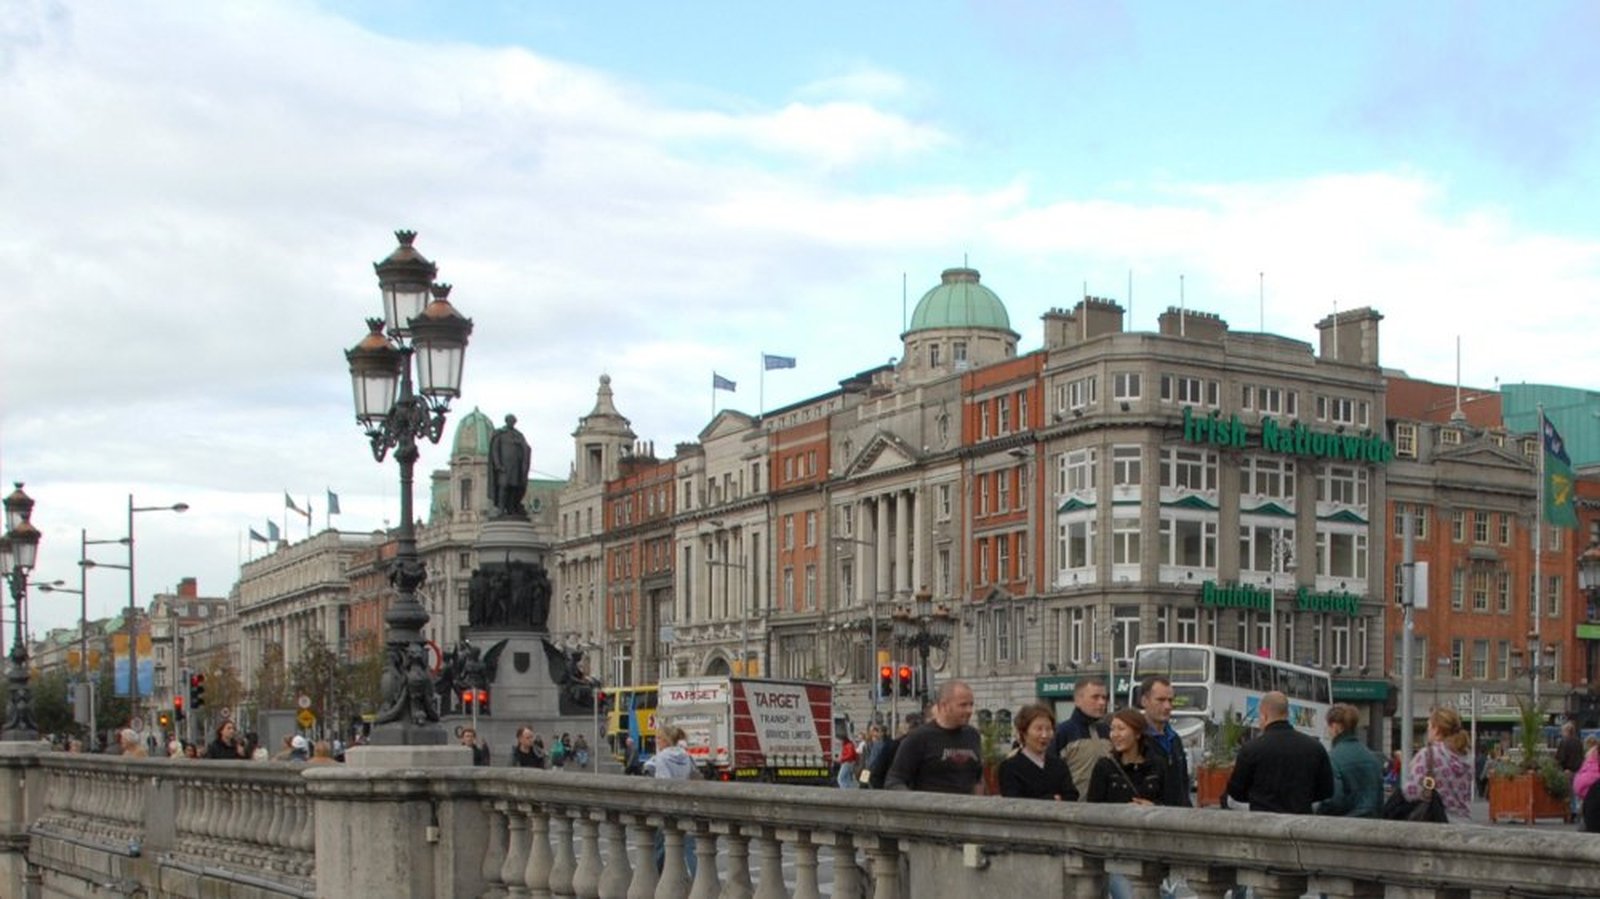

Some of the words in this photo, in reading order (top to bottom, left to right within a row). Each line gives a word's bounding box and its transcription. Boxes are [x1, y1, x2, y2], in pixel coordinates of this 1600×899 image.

[1183, 406, 1247, 448] Irish
[1261, 416, 1394, 463] Nationwide
[1298, 587, 1360, 617] Society
[669, 689, 719, 701] TARGET
[754, 691, 800, 709] TARGET
[760, 714, 806, 724] TRANSPRT
